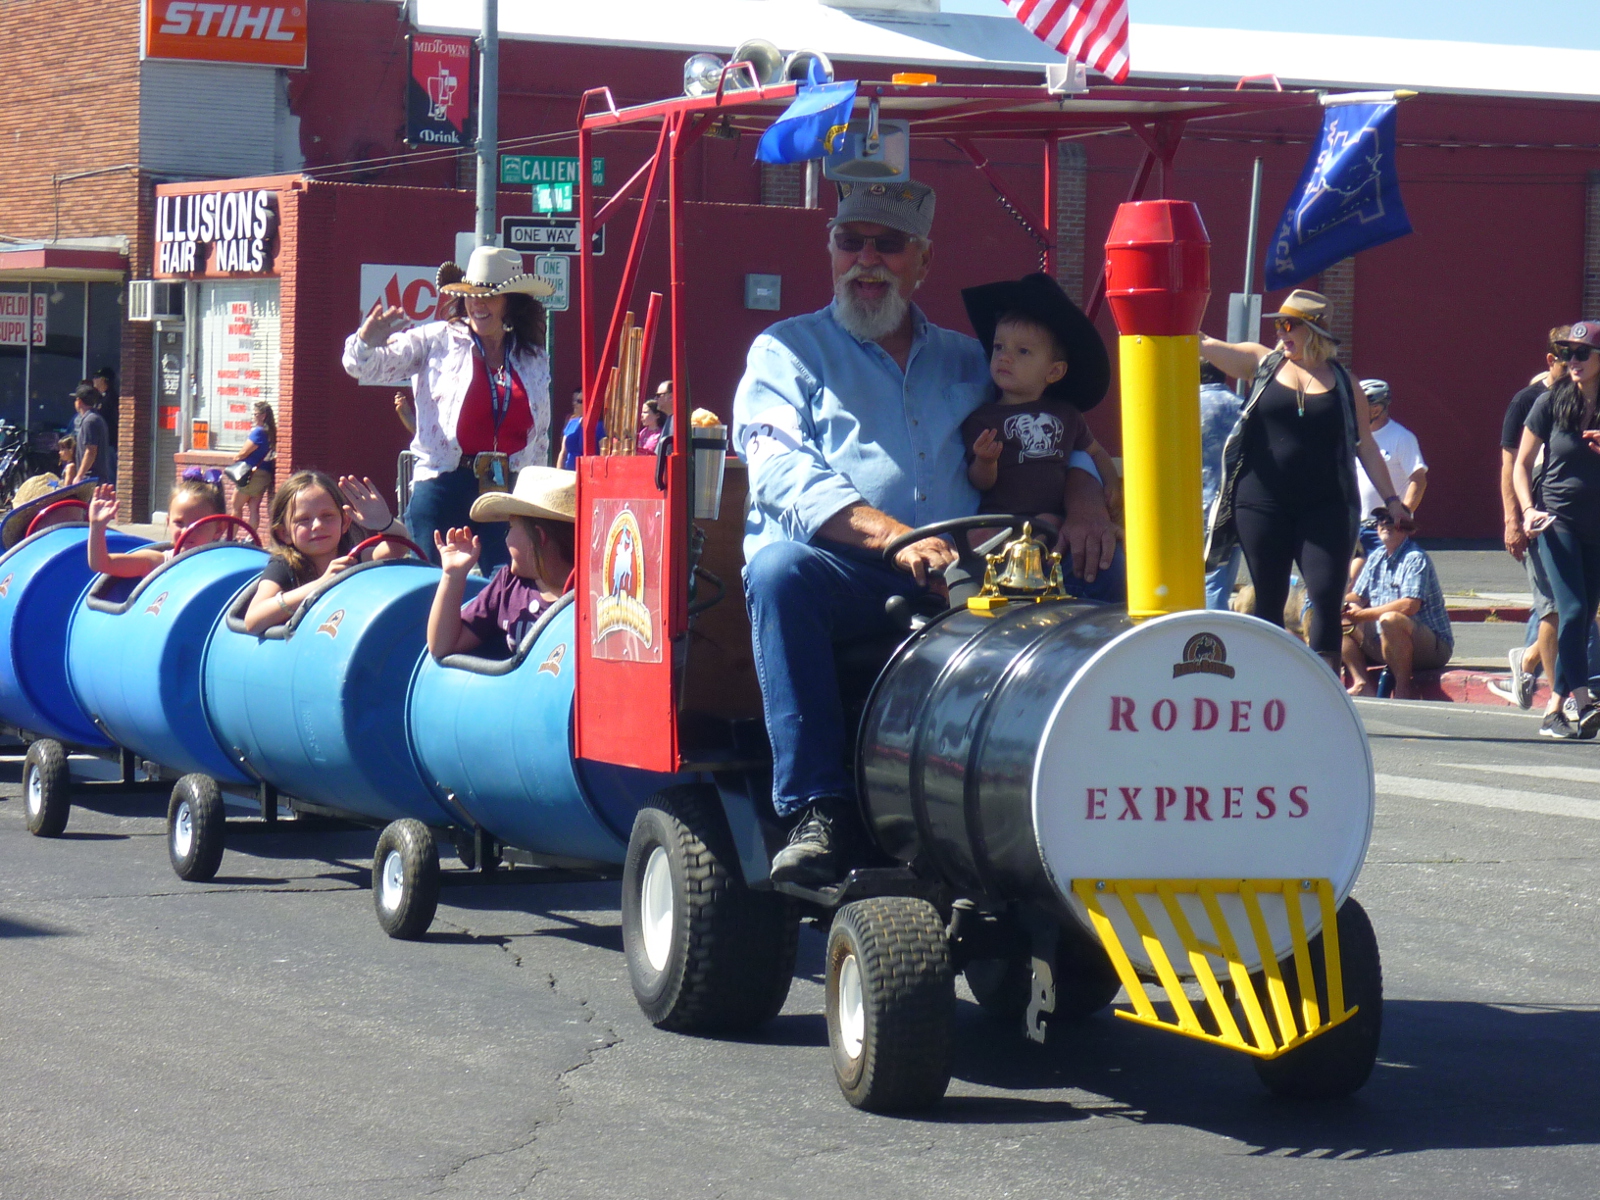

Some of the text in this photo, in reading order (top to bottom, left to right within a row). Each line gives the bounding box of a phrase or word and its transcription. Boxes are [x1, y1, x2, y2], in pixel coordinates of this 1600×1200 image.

[159, 1, 295, 41] STIHL
[420, 129, 460, 143] Drink
[522, 160, 581, 181] CALIEN
[593, 160, 602, 171] ST
[156, 189, 268, 243] ILLUSIONS
[514, 228, 574, 243] ONE WAY
[160, 238, 264, 273] HAIR NAILS
[543, 260, 561, 274] ONE
[0, 322, 43, 343] UPPLES
[1109, 696, 1286, 732] RODEO
[1085, 785, 1309, 821] EXPRESS
